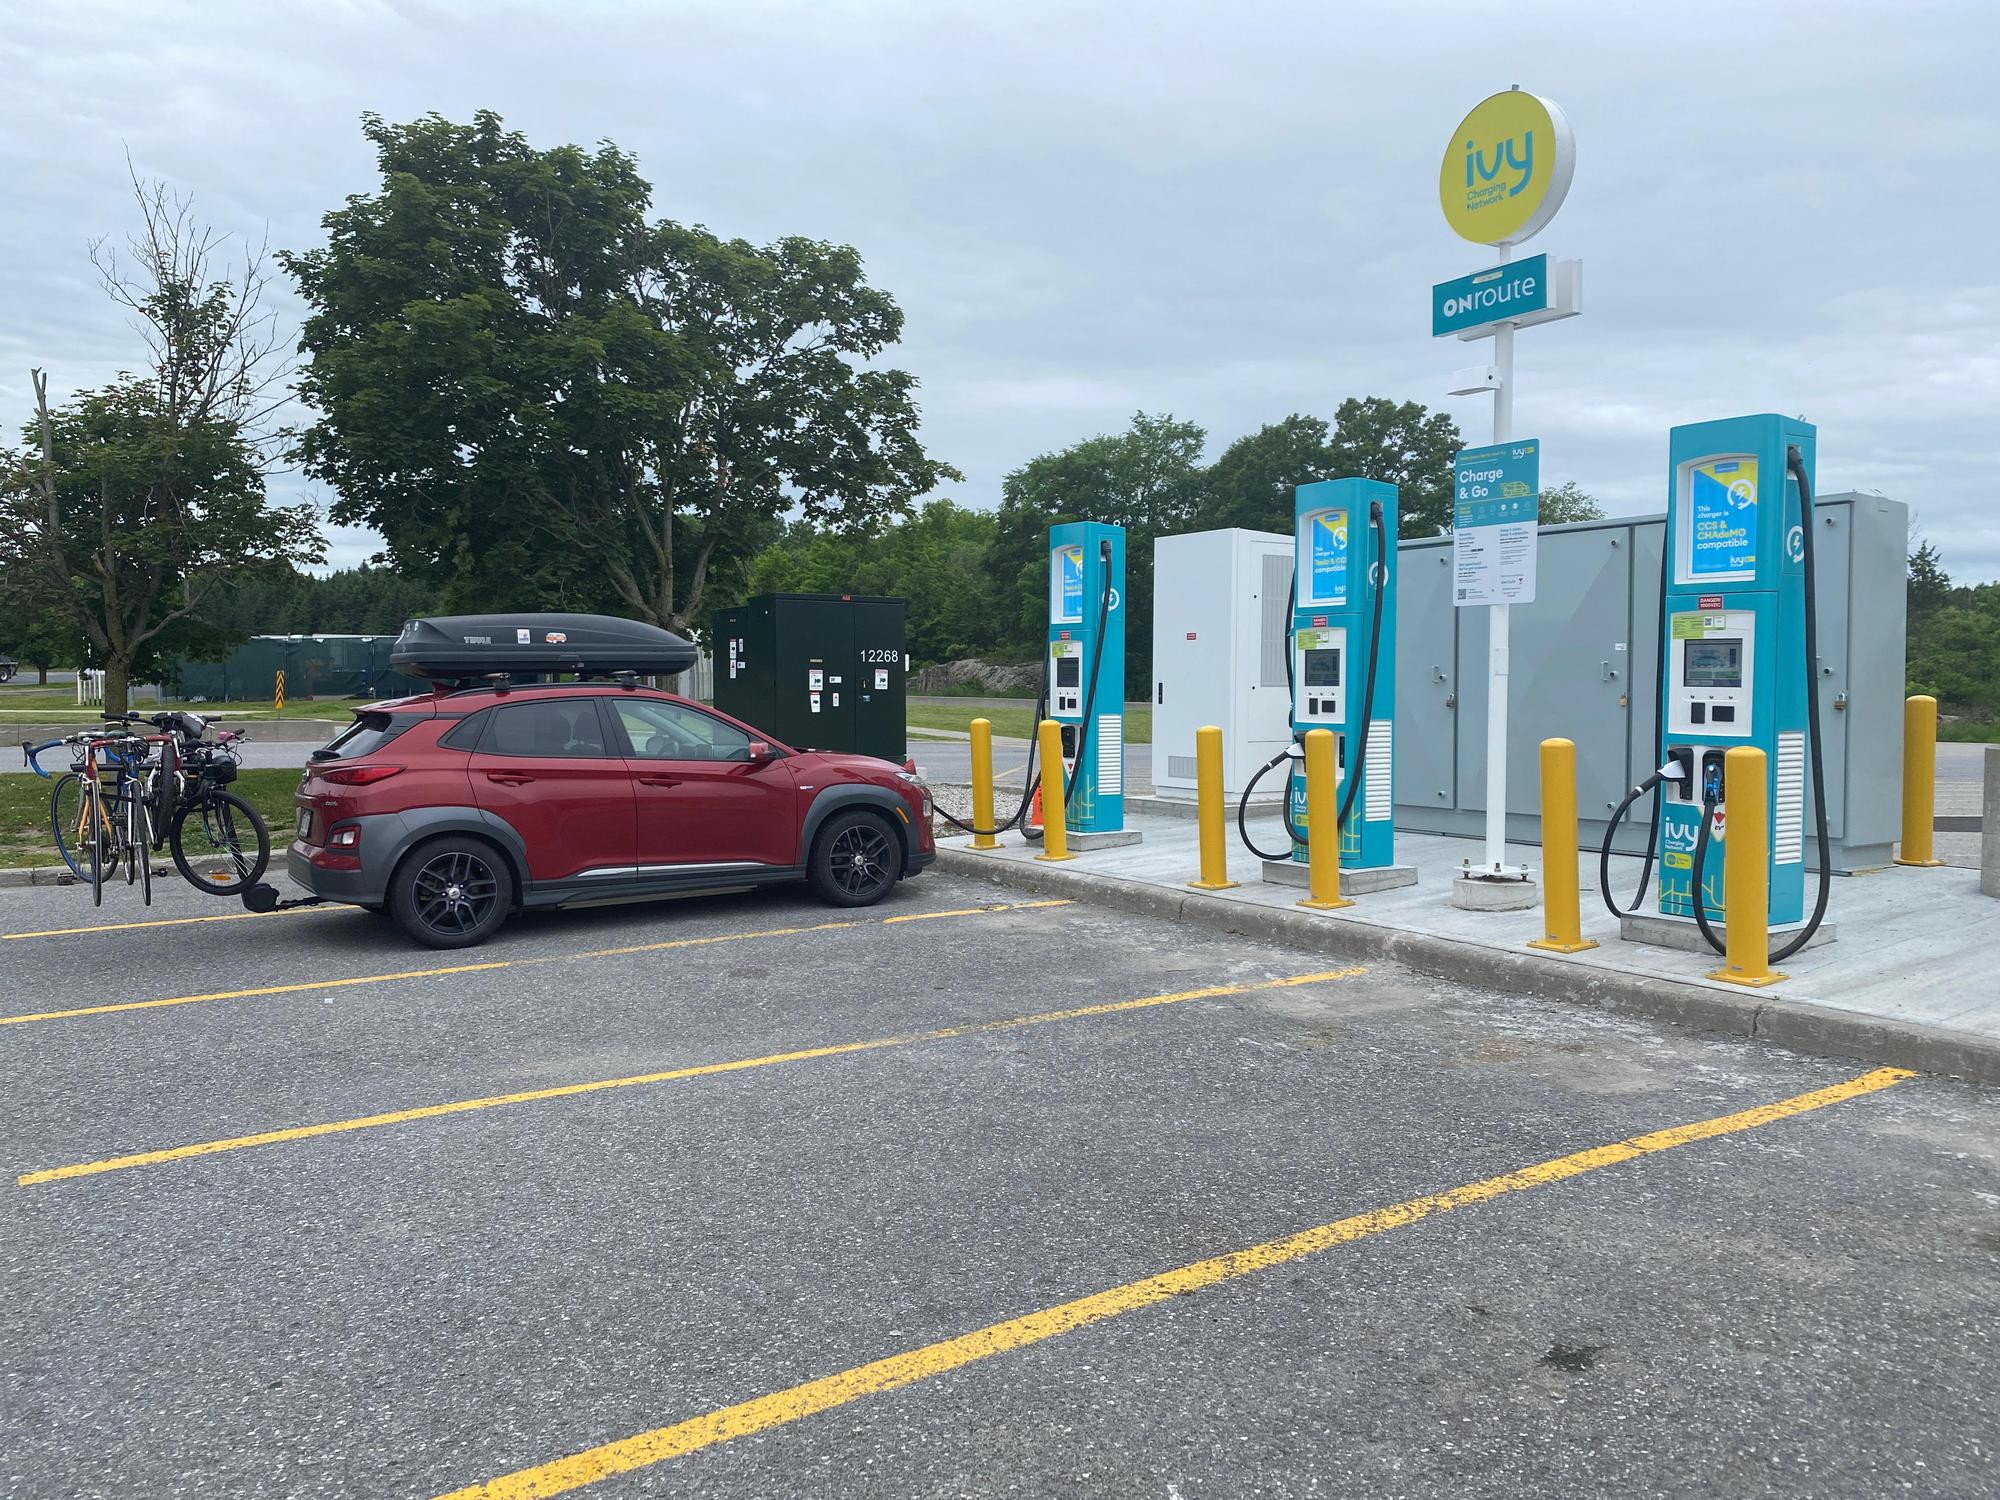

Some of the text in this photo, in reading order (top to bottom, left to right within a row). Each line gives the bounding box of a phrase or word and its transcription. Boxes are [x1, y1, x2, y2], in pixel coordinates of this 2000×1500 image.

[1466, 130, 1533, 197] ivy
[1467, 181, 1507, 202] Charging
[1467, 193, 1504, 213] Network
[1443, 276, 1536, 318] ONroute
[1512, 447, 1525, 459] ivy
[1459, 469, 1504, 484] Charge
[1459, 485, 1489, 500] & Go
[1697, 511, 1723, 519] charger
[1697, 521, 1718, 531] CCS
[1697, 538, 1749, 550] compatible
[1730, 555, 1744, 567] ivy
[463, 637, 492, 645] THULE
[860, 649, 899, 663] 12268
[1294, 787, 1307, 805] iv
[1665, 816, 1699, 852] ivy
